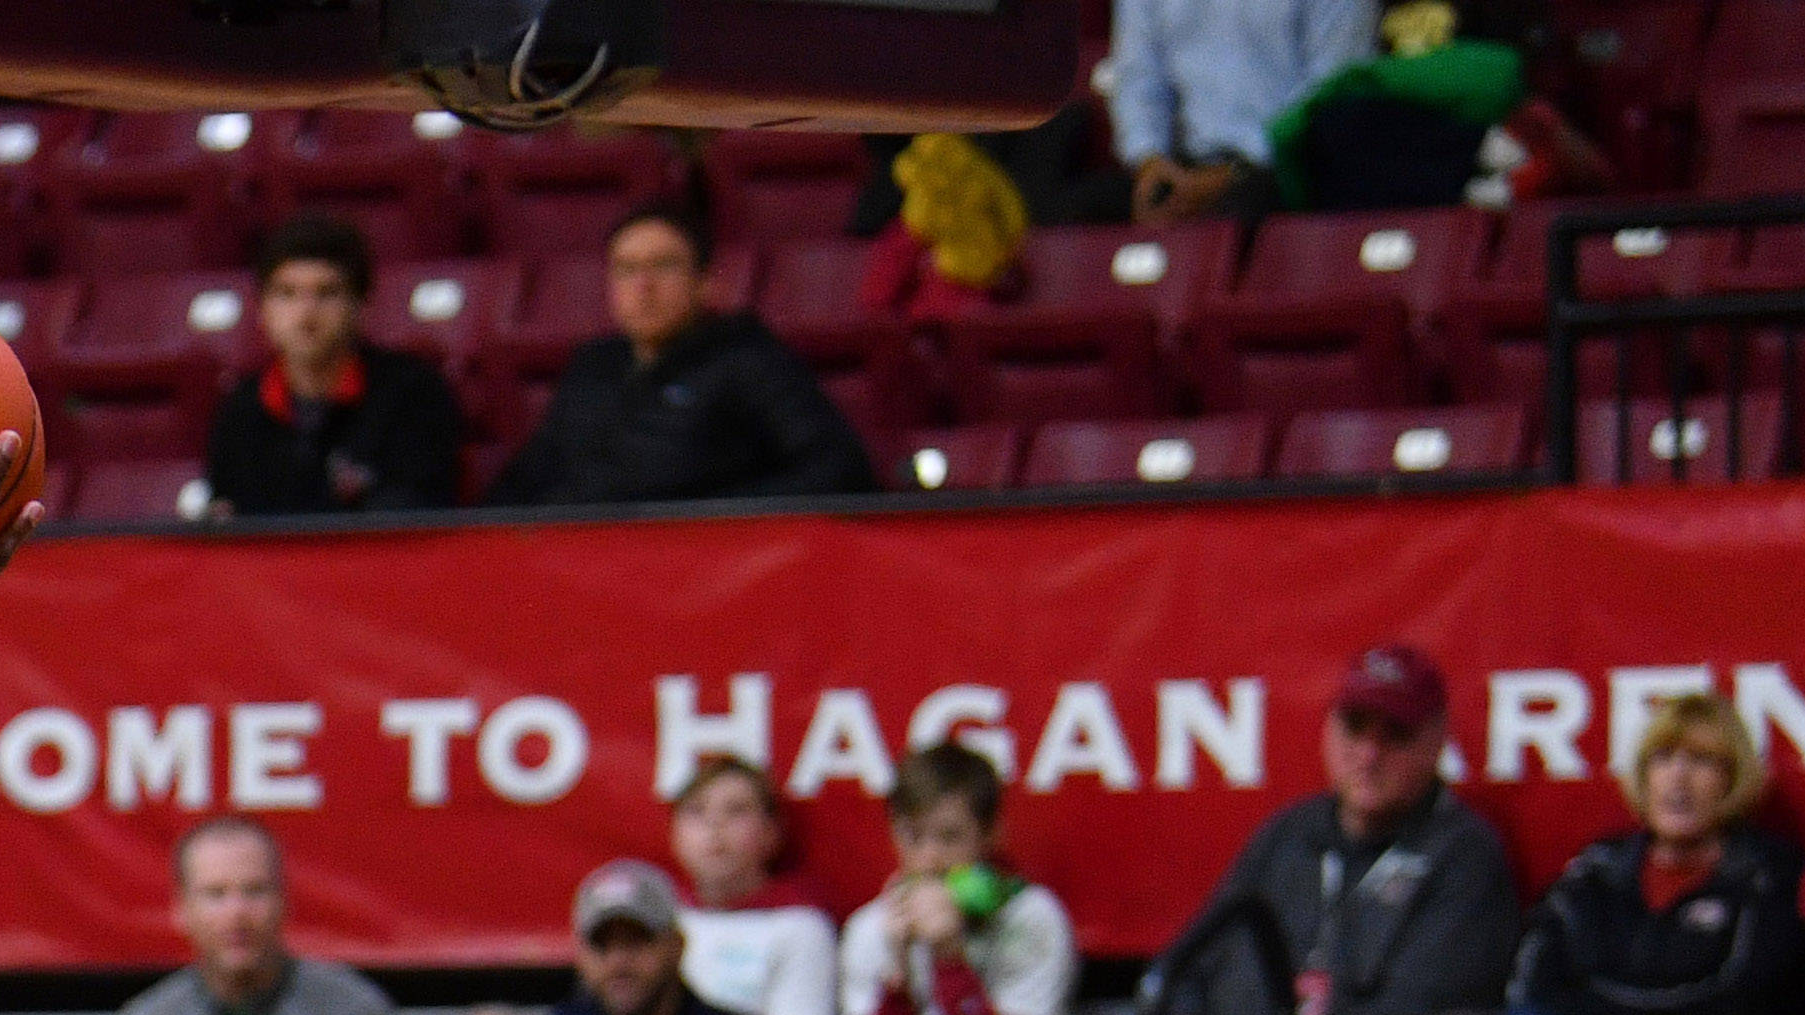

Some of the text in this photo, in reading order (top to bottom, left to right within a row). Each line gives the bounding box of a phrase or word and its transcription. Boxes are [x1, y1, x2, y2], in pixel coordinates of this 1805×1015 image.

[381, 695, 590, 805] TO
[654, 672, 1267, 800] HAGAN
[1437, 662, 1805, 784] REN
